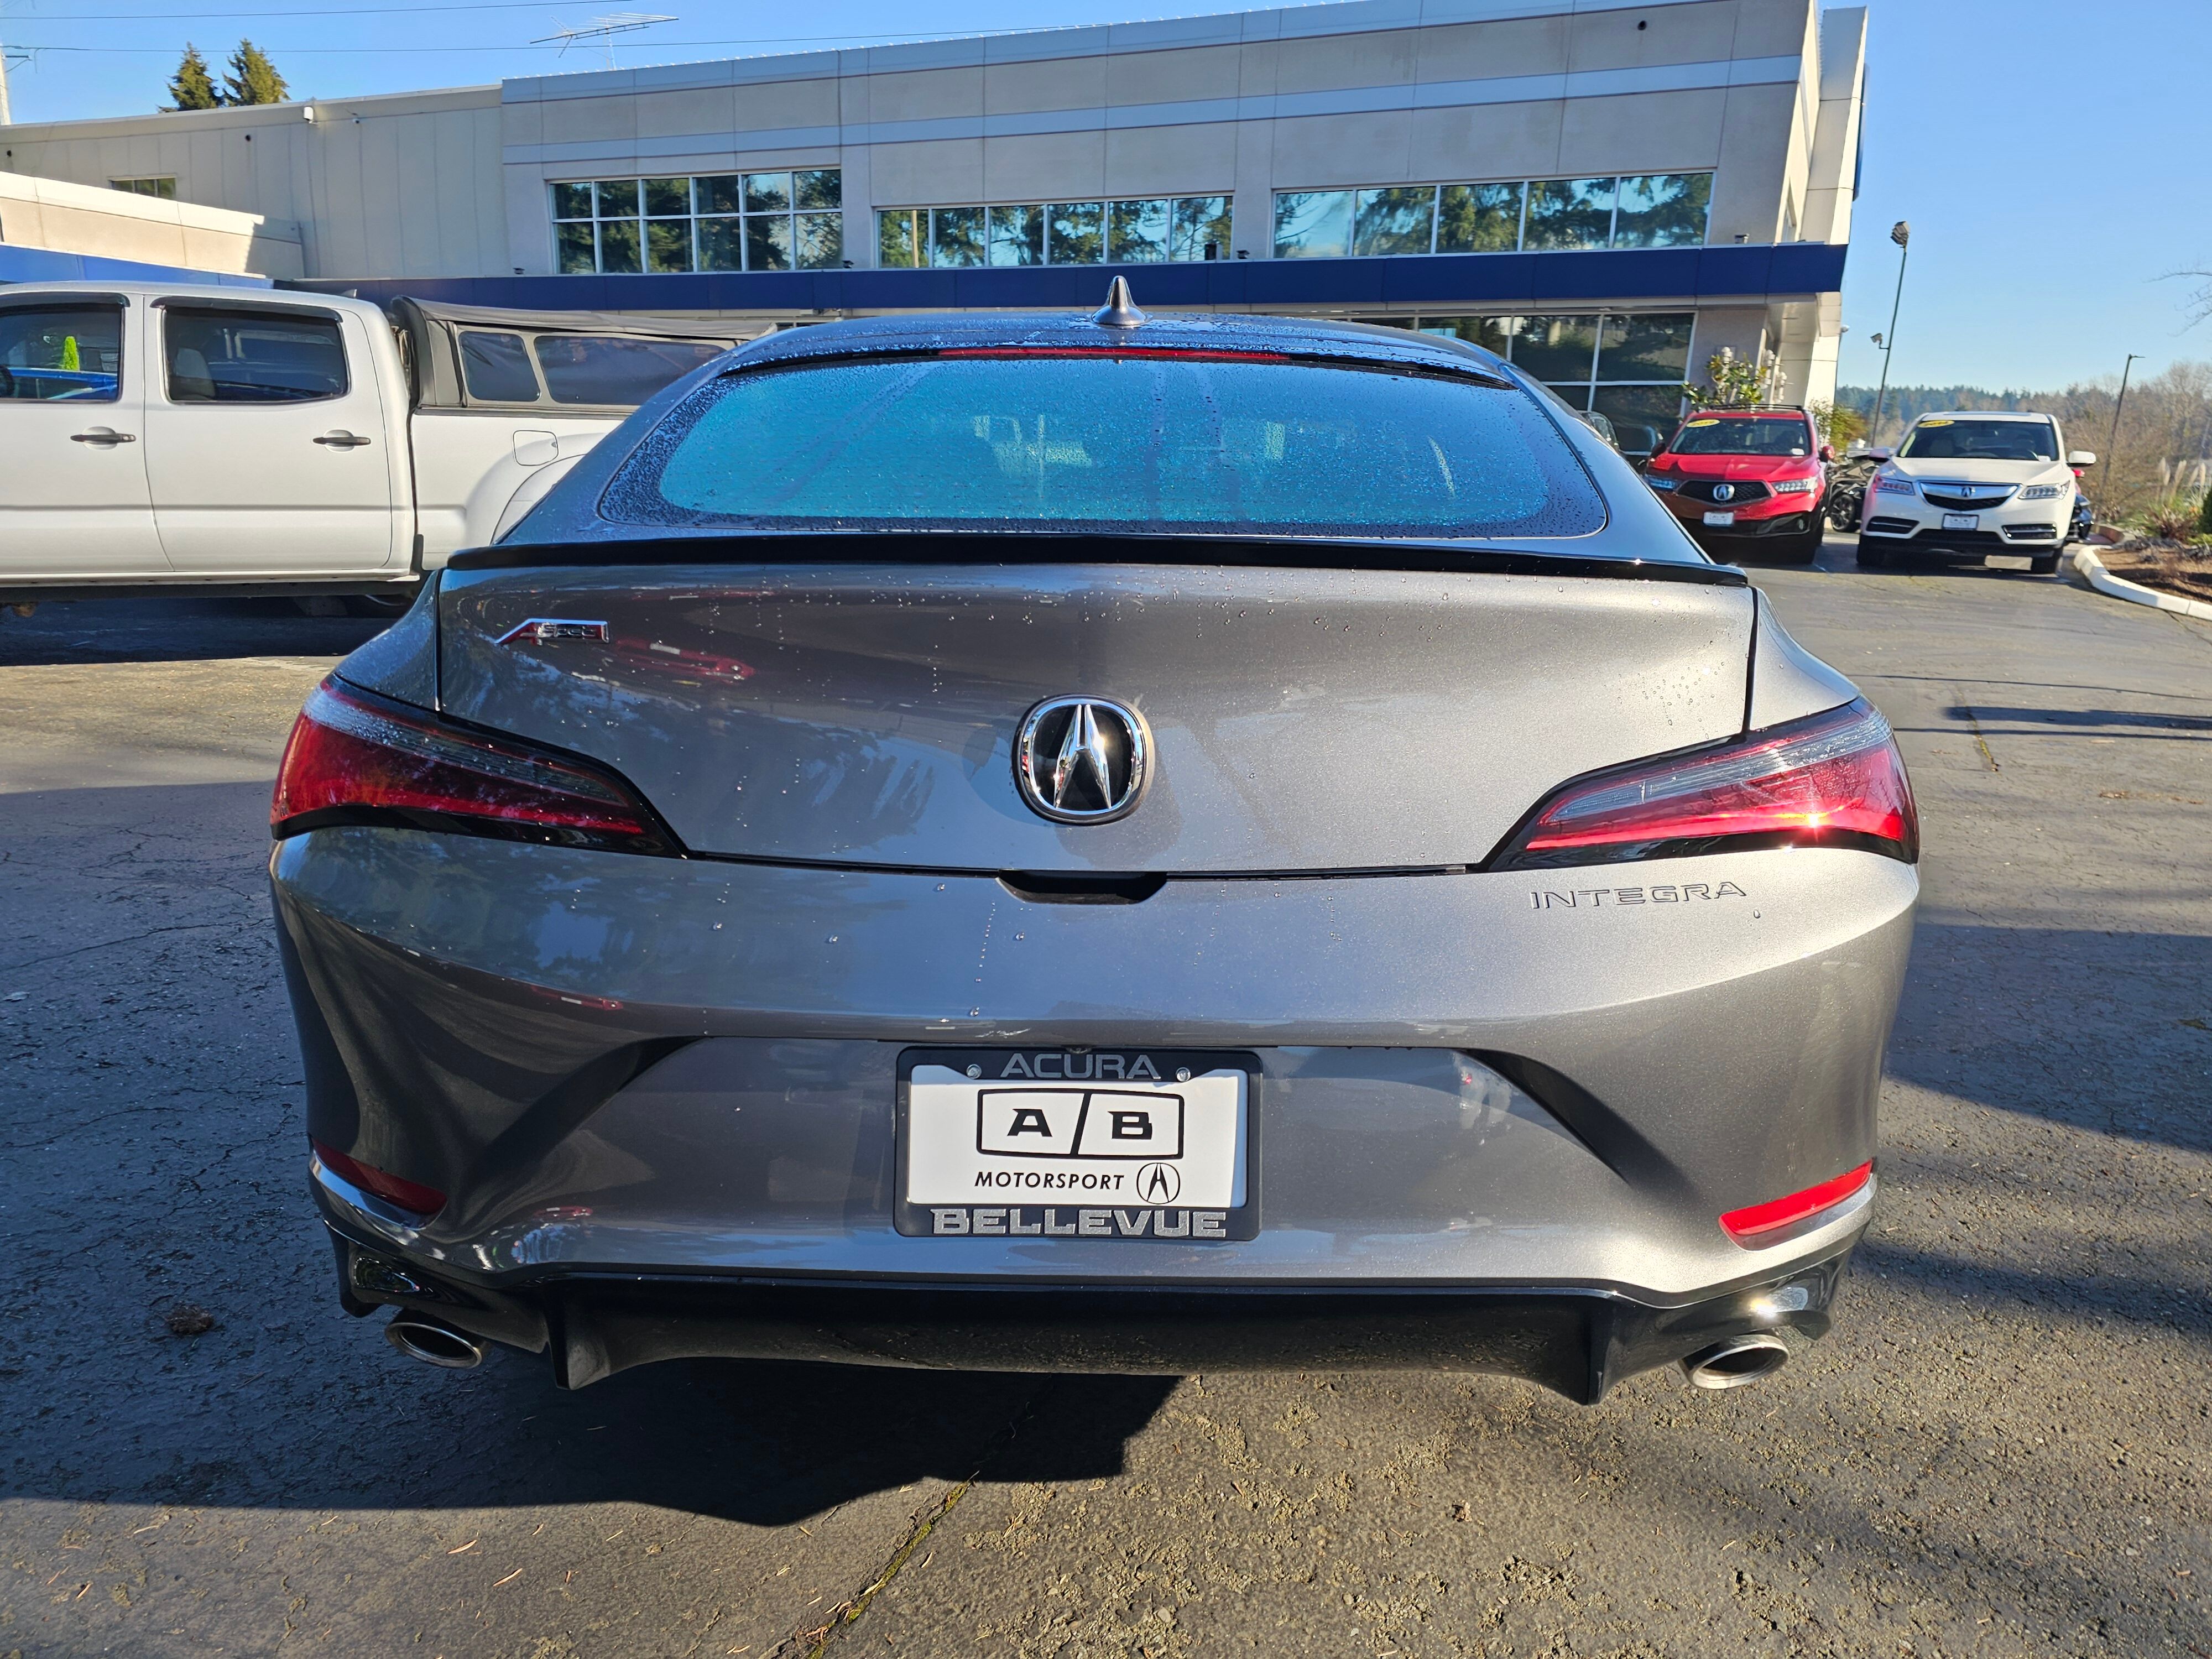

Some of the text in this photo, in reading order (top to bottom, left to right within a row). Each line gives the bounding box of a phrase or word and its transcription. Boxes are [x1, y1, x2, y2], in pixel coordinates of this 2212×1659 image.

[1530, 881, 1747, 909] INTEGRA
[1000, 1053, 1161, 1079] ACURA
[1006, 1108, 1152, 1140] A B
[975, 1172, 1124, 1190] MOTORSPORT
[930, 1208, 1226, 1238] BELLEVUE
